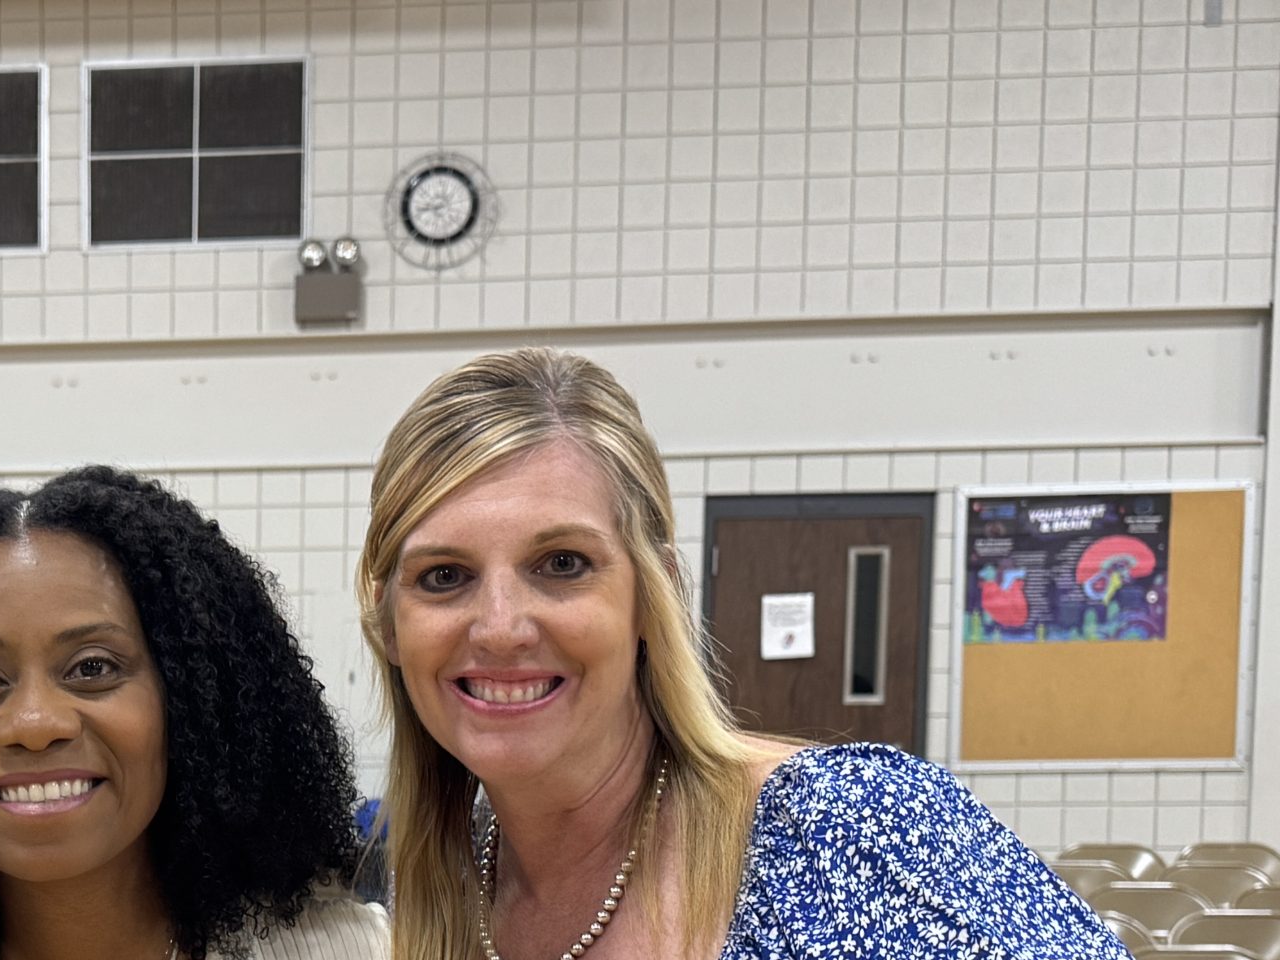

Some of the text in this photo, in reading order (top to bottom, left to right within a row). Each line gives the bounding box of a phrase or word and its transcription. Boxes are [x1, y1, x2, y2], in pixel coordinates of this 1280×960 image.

[1028, 507, 1063, 523] YOUR
[1064, 504, 1106, 519] HEART
[1052, 518, 1092, 532] BRAIN
